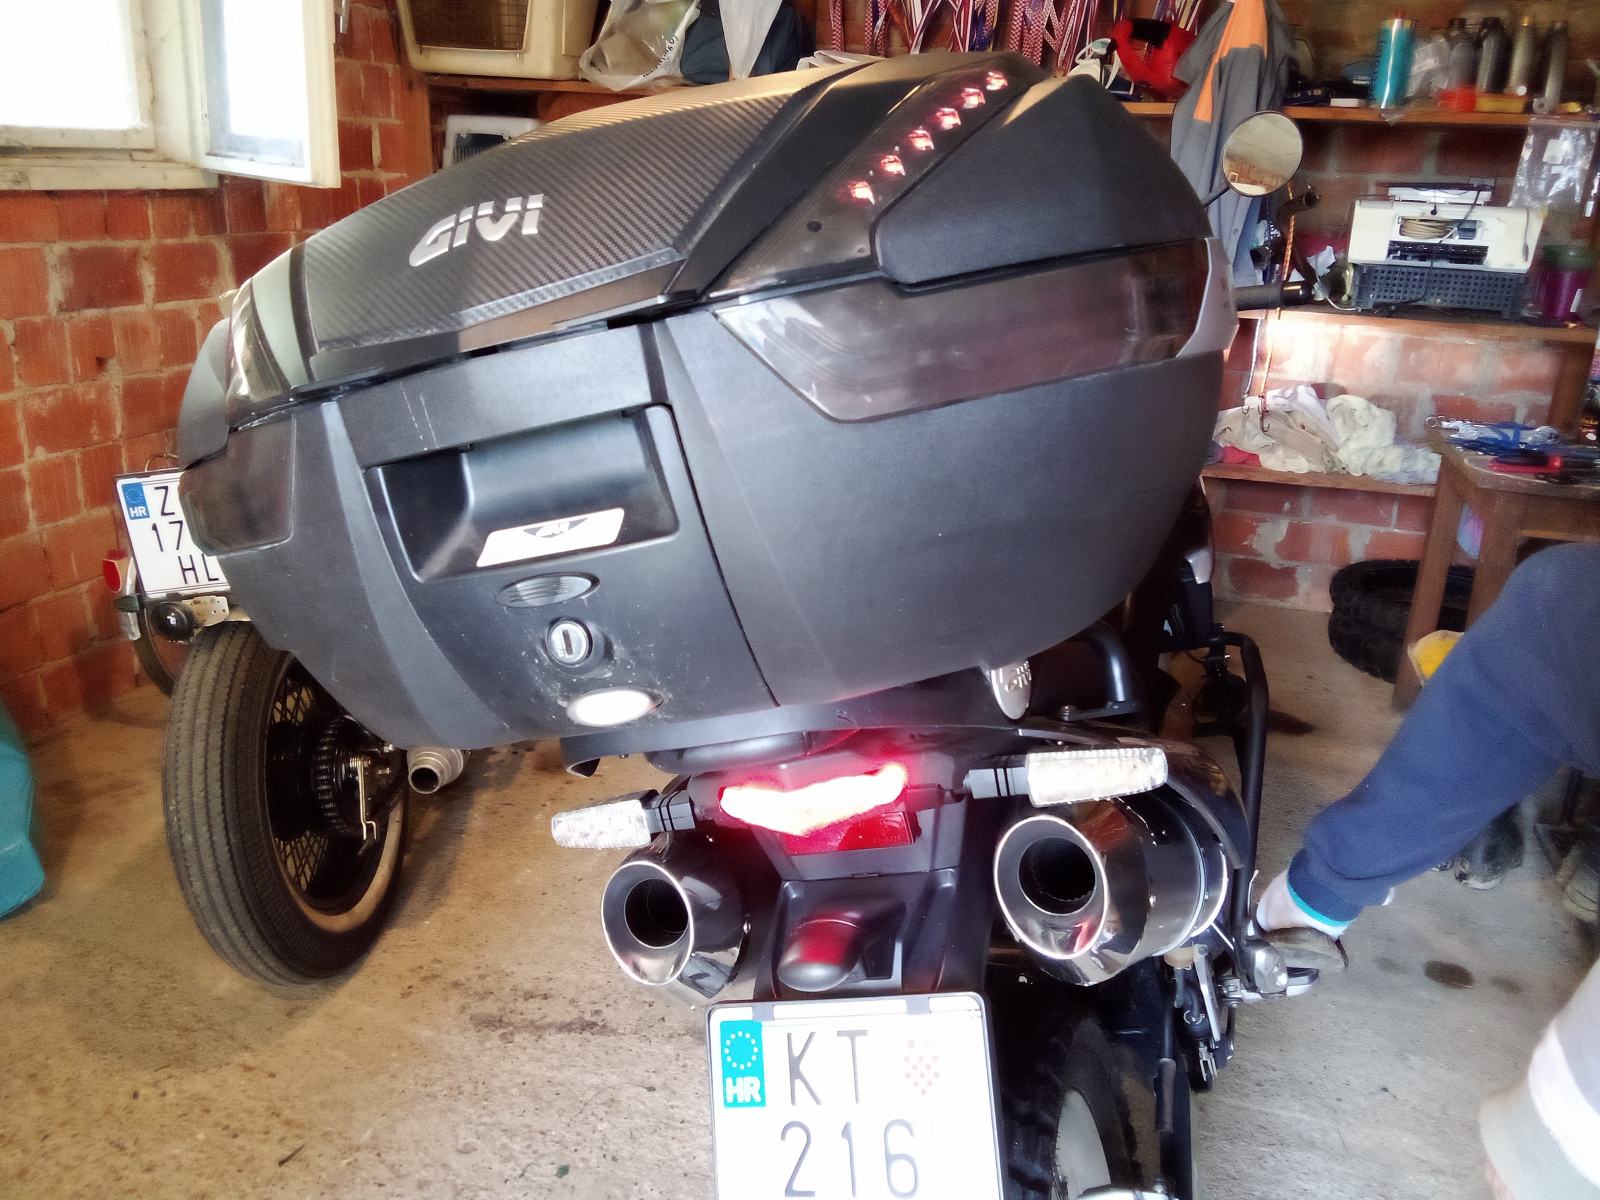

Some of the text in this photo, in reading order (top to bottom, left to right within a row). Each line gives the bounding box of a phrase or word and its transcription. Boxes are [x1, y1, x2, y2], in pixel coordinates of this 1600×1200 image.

[409, 194, 544, 267] GIVI
[129, 506, 147, 518] HR
[154, 486, 175, 516] Z
[178, 553, 219, 584] HL
[725, 1076, 762, 1103] HR
[781, 1119, 919, 1199] 216
